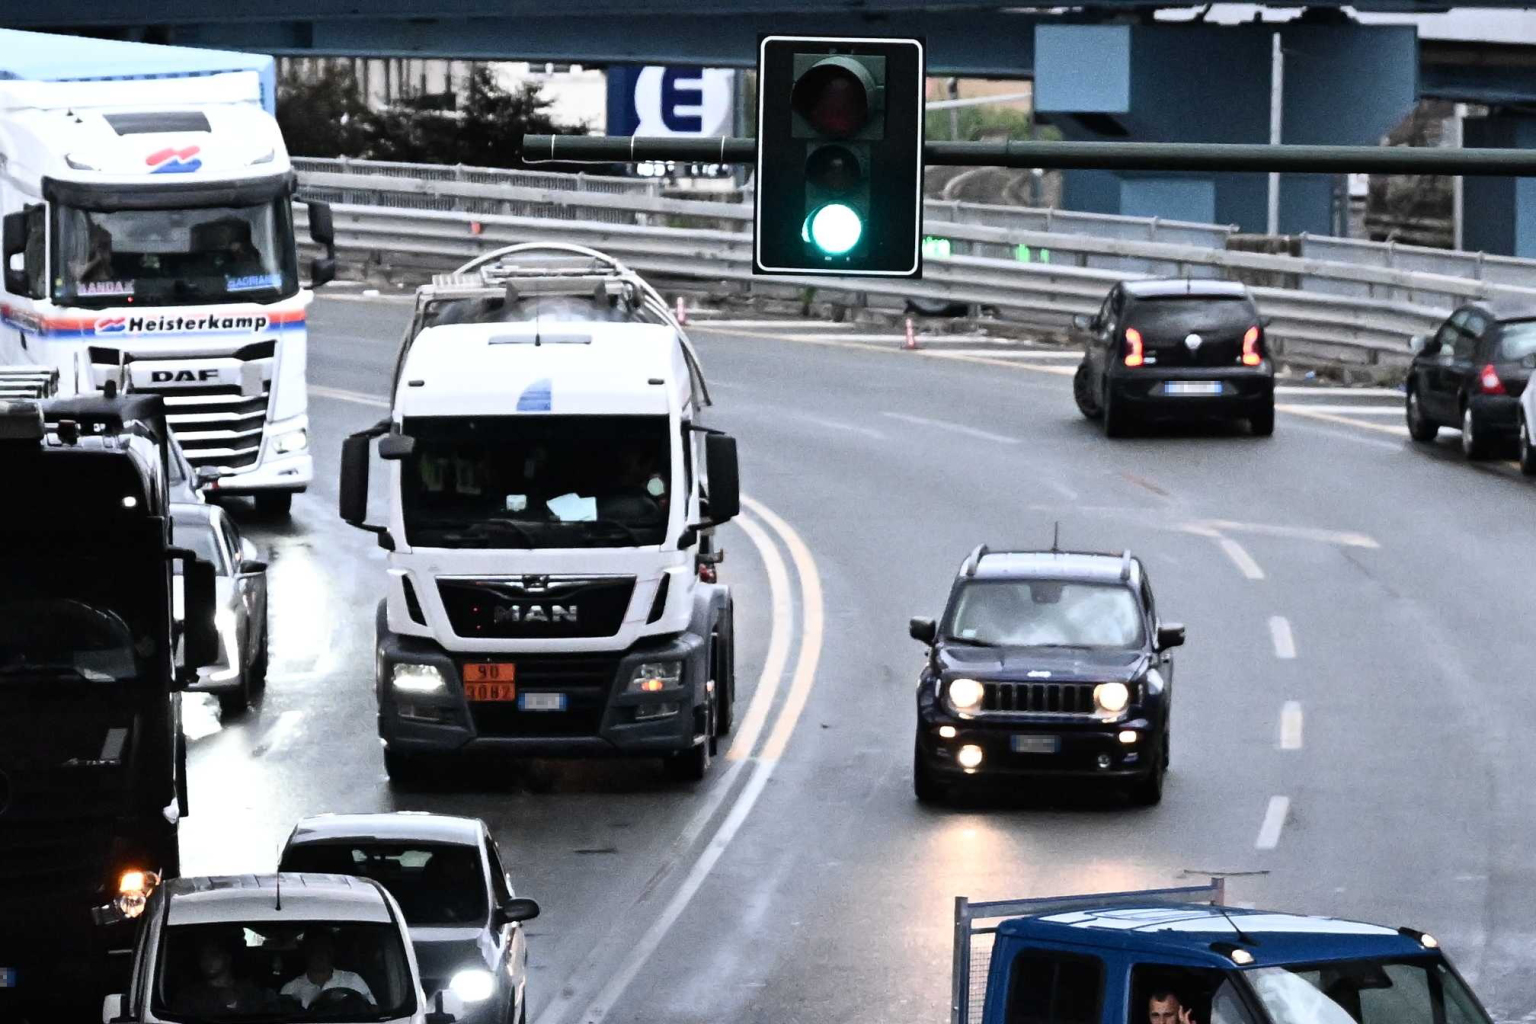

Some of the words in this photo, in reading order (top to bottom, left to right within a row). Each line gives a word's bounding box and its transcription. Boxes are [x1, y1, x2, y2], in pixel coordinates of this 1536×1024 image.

[129, 314, 267, 332] Heisterkamp
[151, 369, 219, 382] DAF
[494, 605, 578, 622] MAN
[478, 665, 500, 680] 90
[466, 684, 511, 700] 3082
